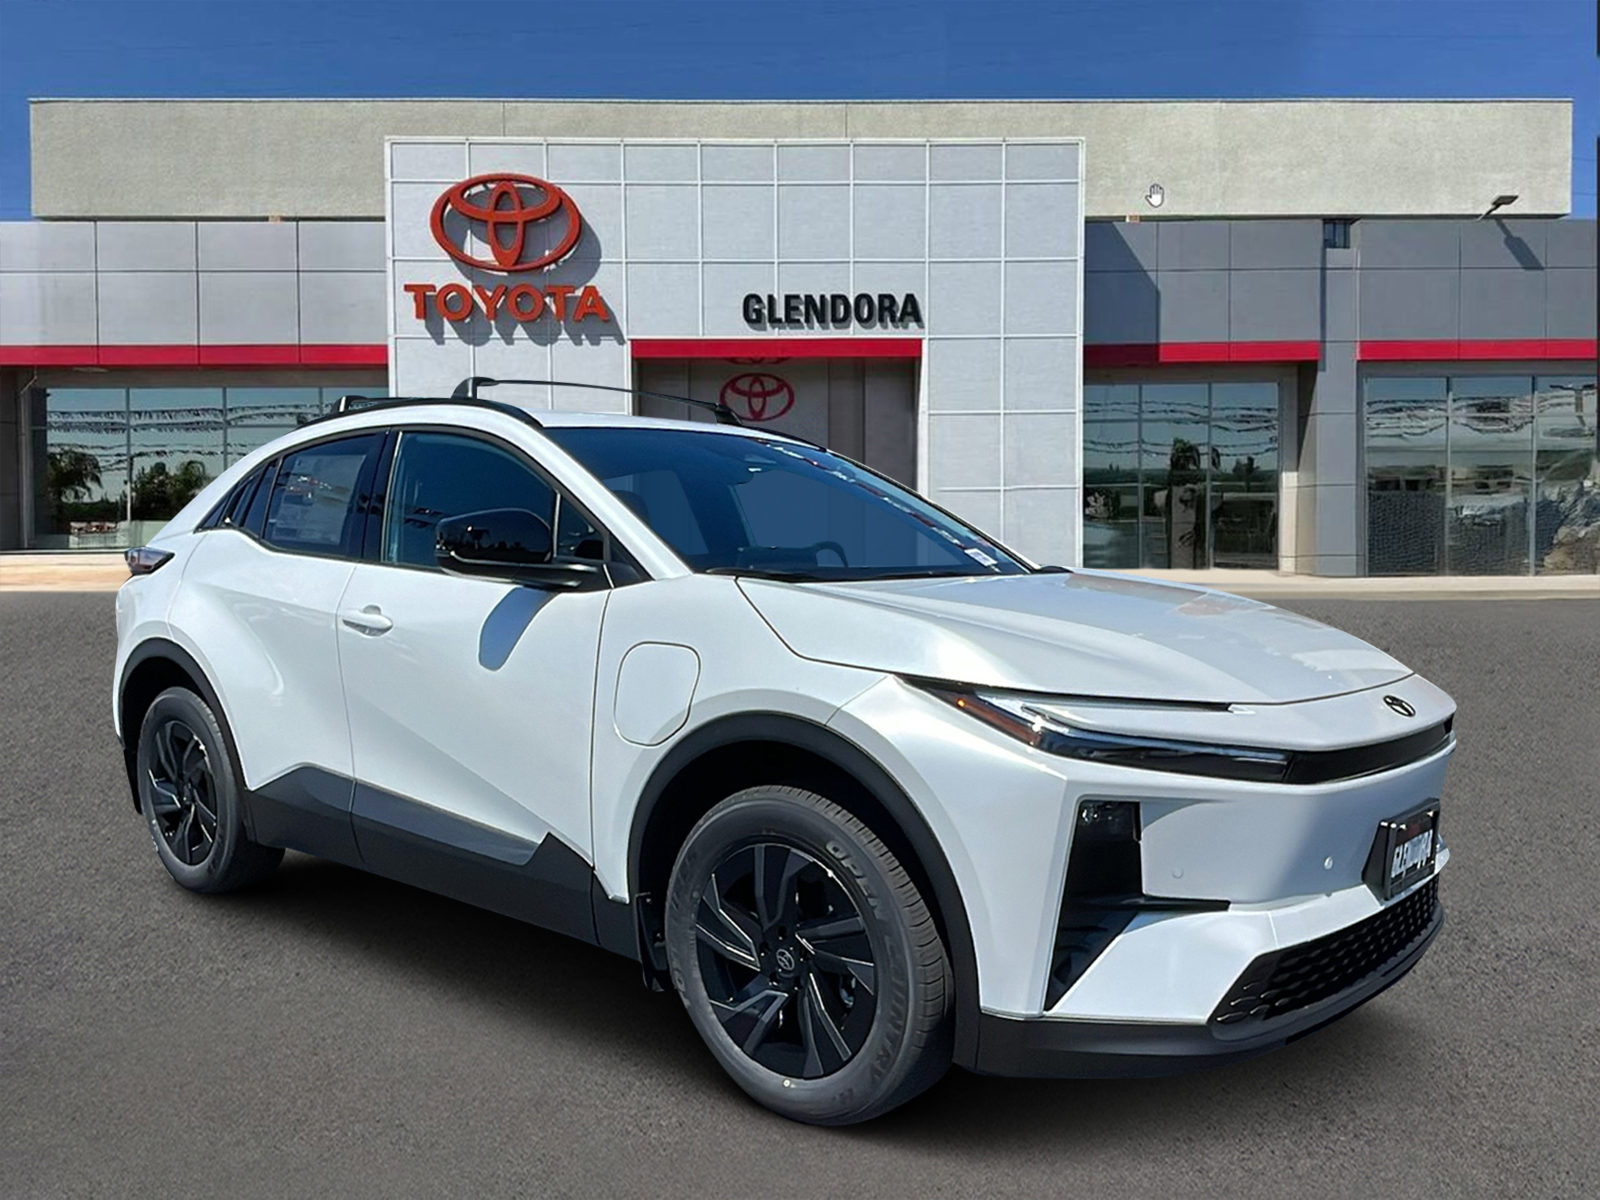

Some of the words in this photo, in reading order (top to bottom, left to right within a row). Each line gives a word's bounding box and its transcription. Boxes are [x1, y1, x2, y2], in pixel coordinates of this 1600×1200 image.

[404, 283, 610, 322] TOYOTA
[742, 293, 922, 324] GLENDORA
[826, 840, 887, 920] OPEN
